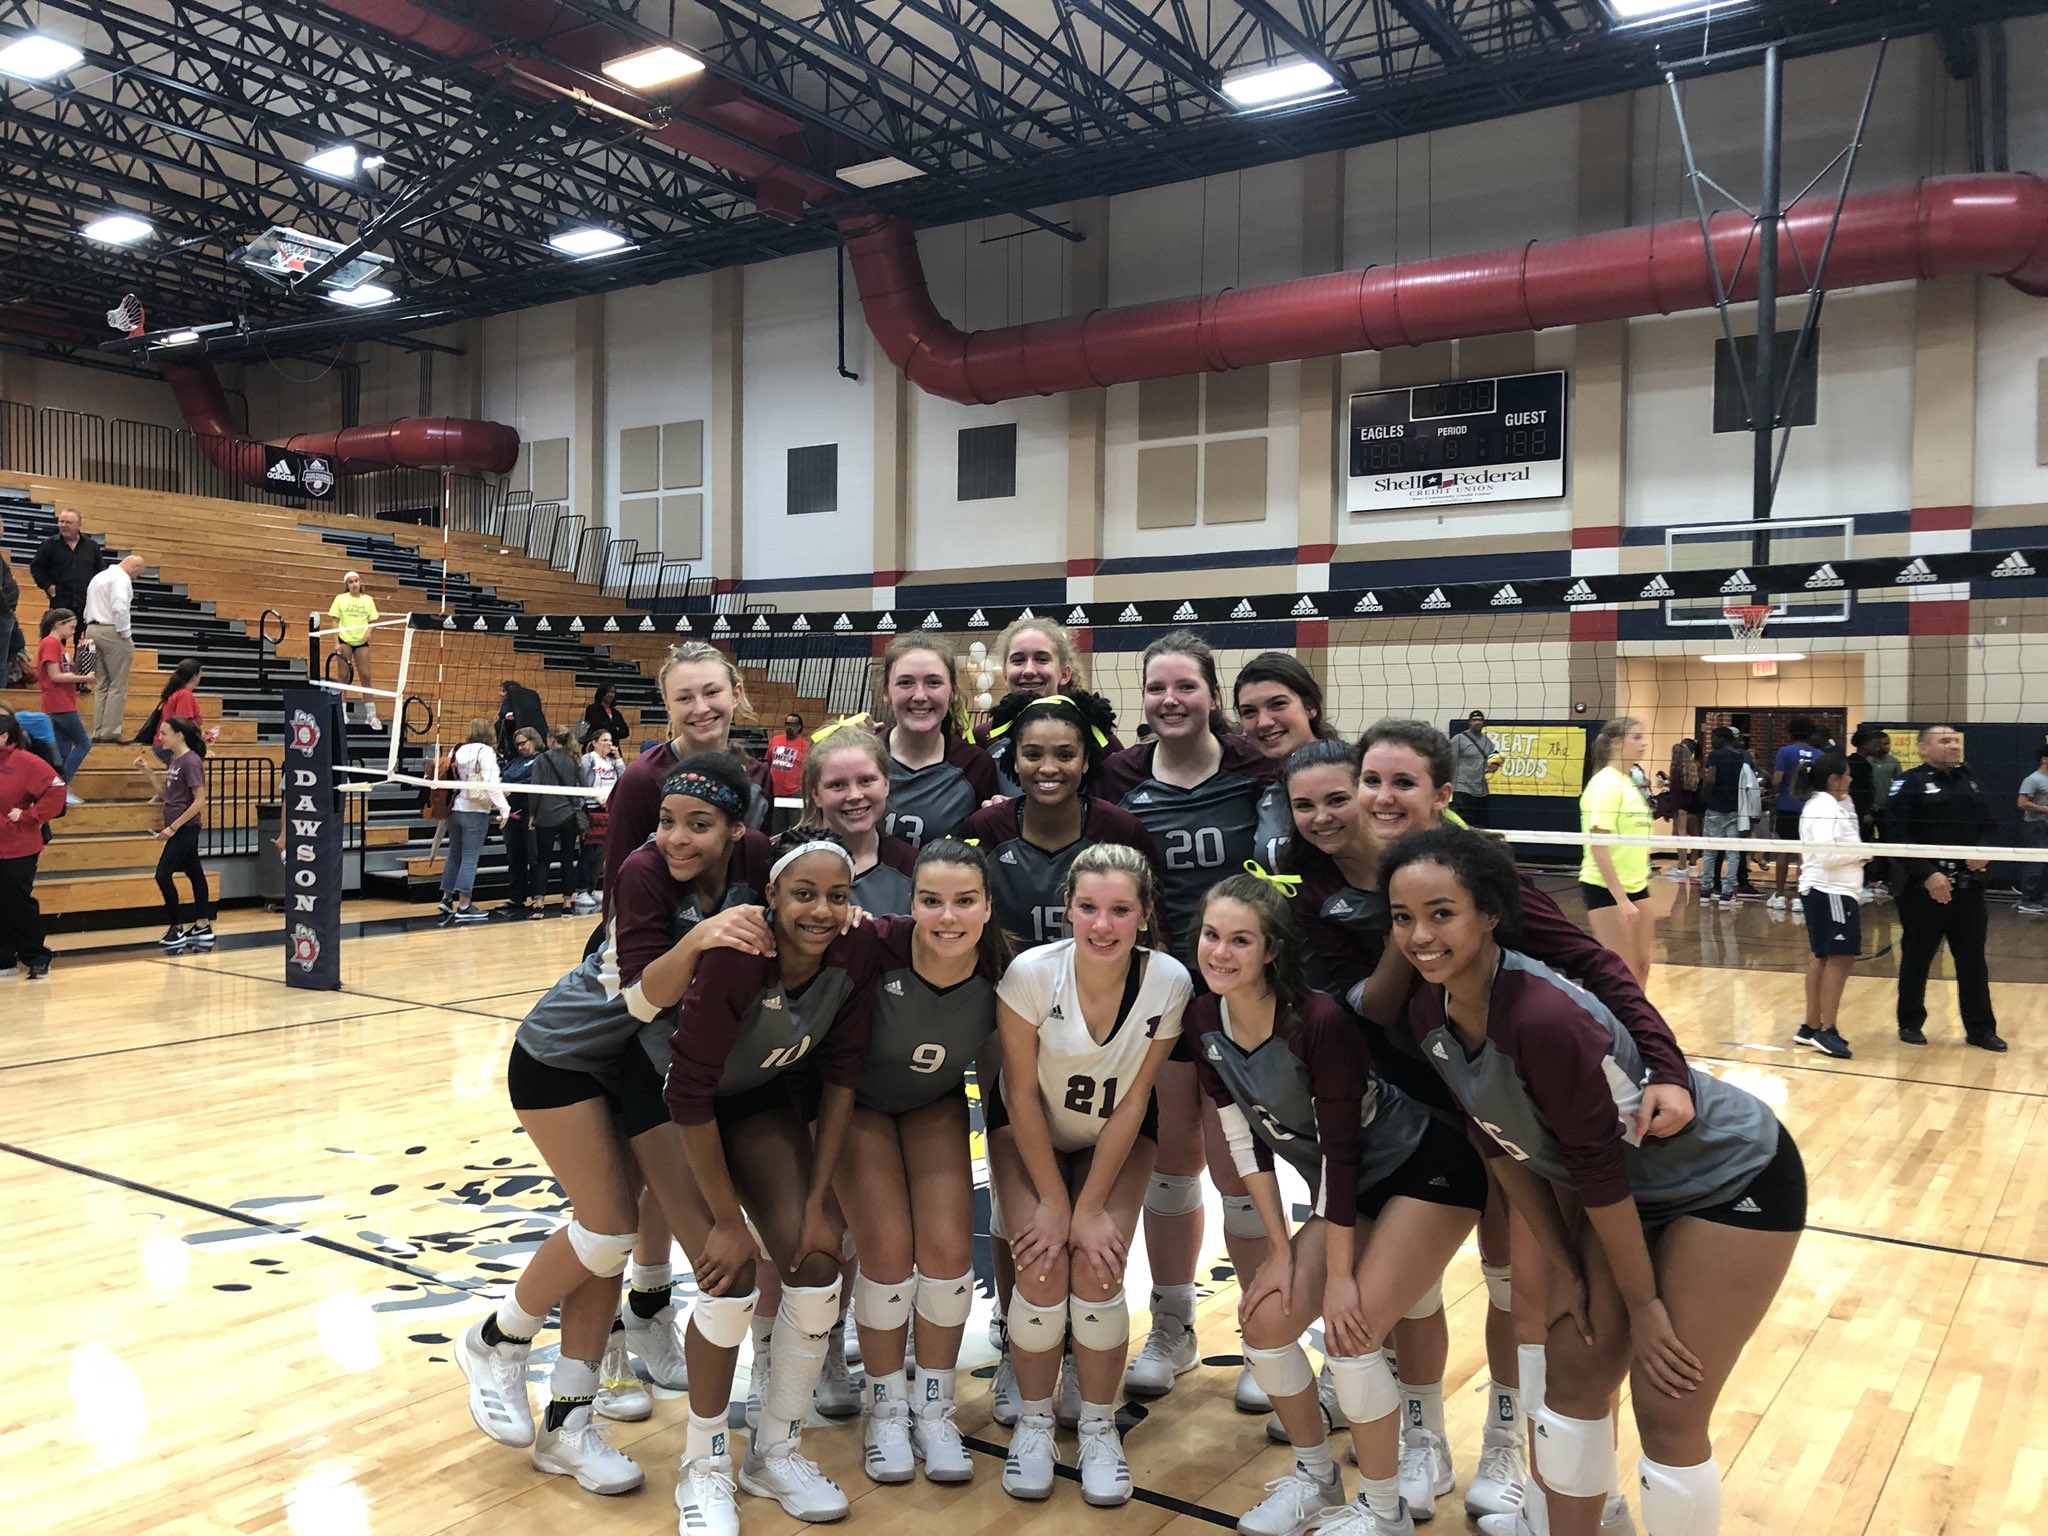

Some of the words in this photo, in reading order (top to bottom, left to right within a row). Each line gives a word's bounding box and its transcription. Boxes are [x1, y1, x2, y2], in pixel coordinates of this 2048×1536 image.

[1505, 410, 1547, 427] GUEST
[1361, 424, 1404, 441] EAGLES
[1437, 425, 1468, 437] PERIOD
[267, 471, 296, 483] adidas
[1374, 475, 1422, 492] Shell
[1454, 467, 1531, 486] Federal
[1409, 488, 1451, 497] CREDIT
[1456, 485, 1494, 493] UNION
[1895, 573, 1938, 583] adidas
[1991, 567, 2037, 577] adidas
[1719, 583, 1757, 593] adidas
[1804, 578, 1845, 588] adidas
[1563, 592, 1597, 601] adidas
[1640, 588, 1675, 597] adidas
[1420, 600, 1452, 609] adidas
[1490, 596, 1523, 605] adidas
[1290, 607, 1319, 616] adidas
[1354, 604, 1384, 612] adidas
[1118, 615, 1143, 623] adidas
[1172, 613, 1199, 621] adidas
[1230, 610, 1257, 619] adidas
[1487, 731, 1539, 756] BEAT
[1547, 741, 1570, 757] the
[1501, 756, 1548, 779] ODDS
[884, 812, 924, 850] 13
[291, 769, 323, 912] DAWSON
[1165, 827, 1226, 870] 20
[1030, 905, 1073, 943] 15
[759, 1034, 812, 1069] 10
[909, 1043, 947, 1074] 9
[1064, 1074, 1118, 1119] 21
